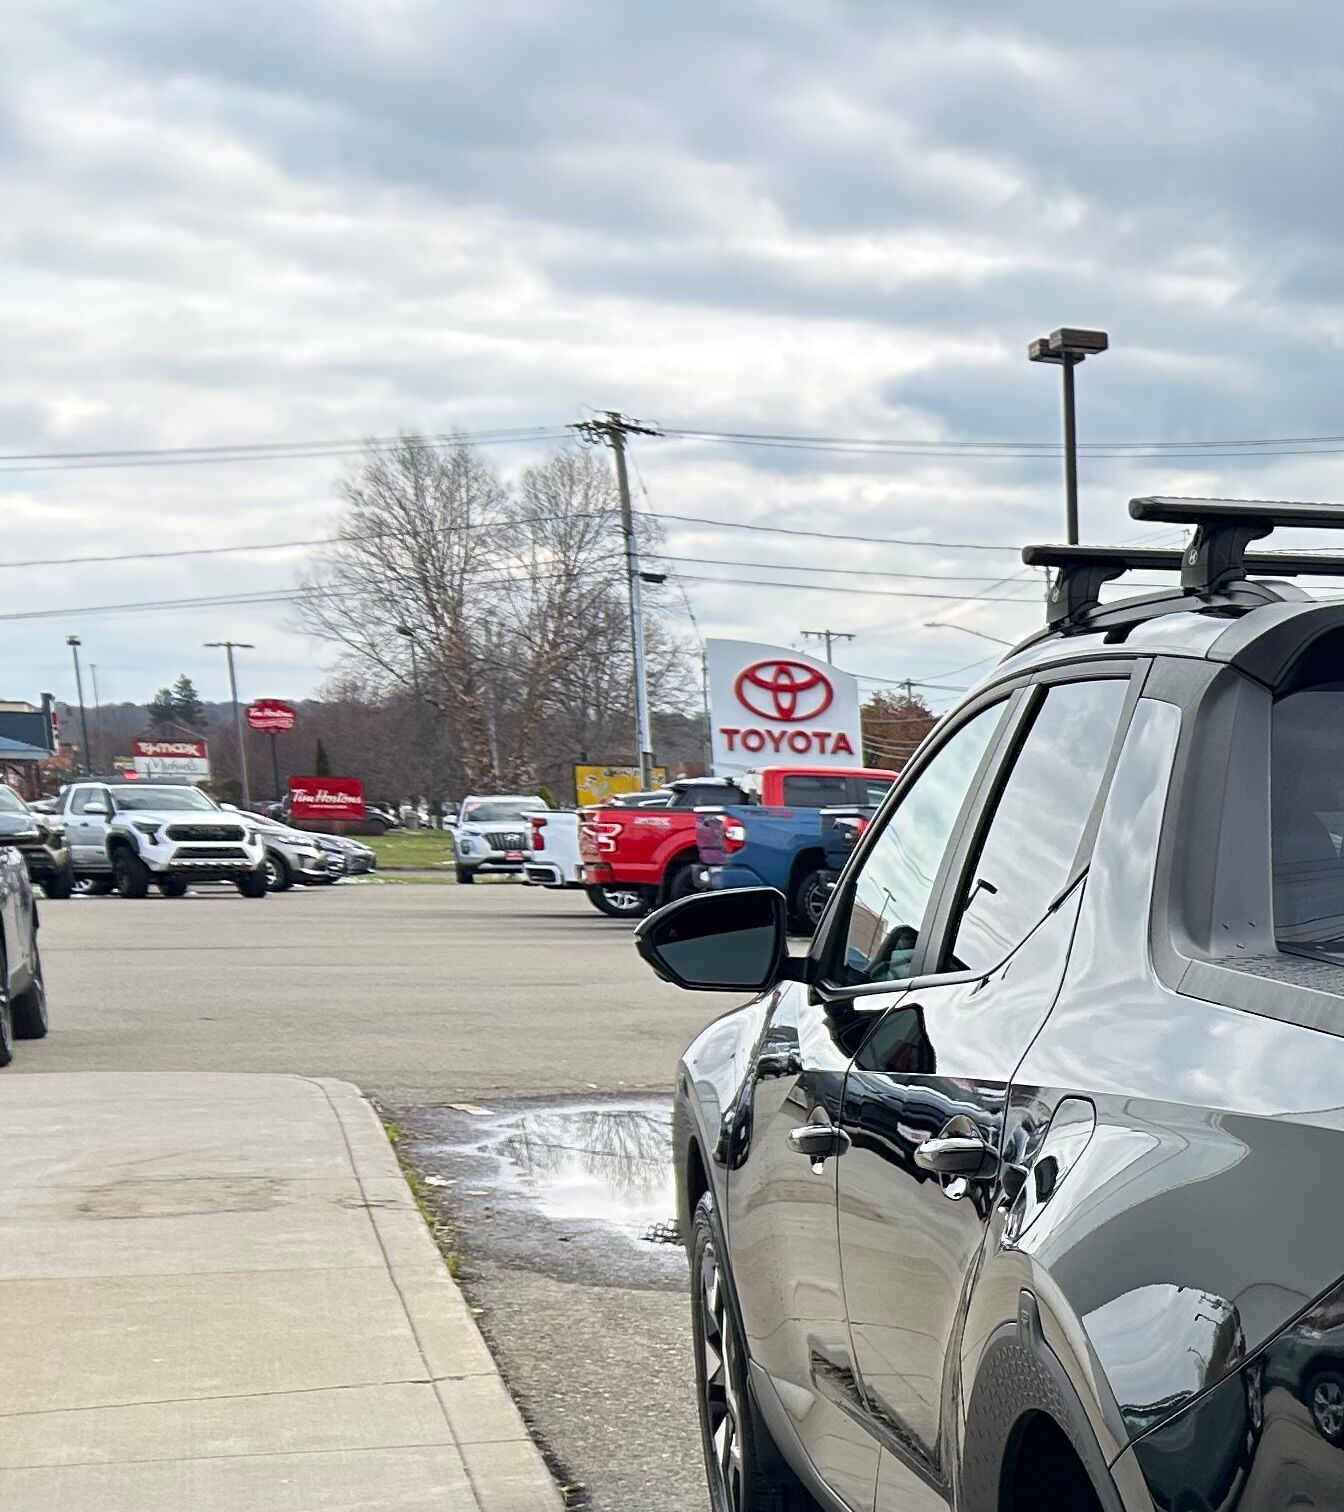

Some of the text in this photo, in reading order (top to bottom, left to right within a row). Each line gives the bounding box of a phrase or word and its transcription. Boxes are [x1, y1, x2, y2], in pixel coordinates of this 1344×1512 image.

[720, 728, 854, 755] TOYOTA
[291, 788, 361, 804] Tim Hortons
